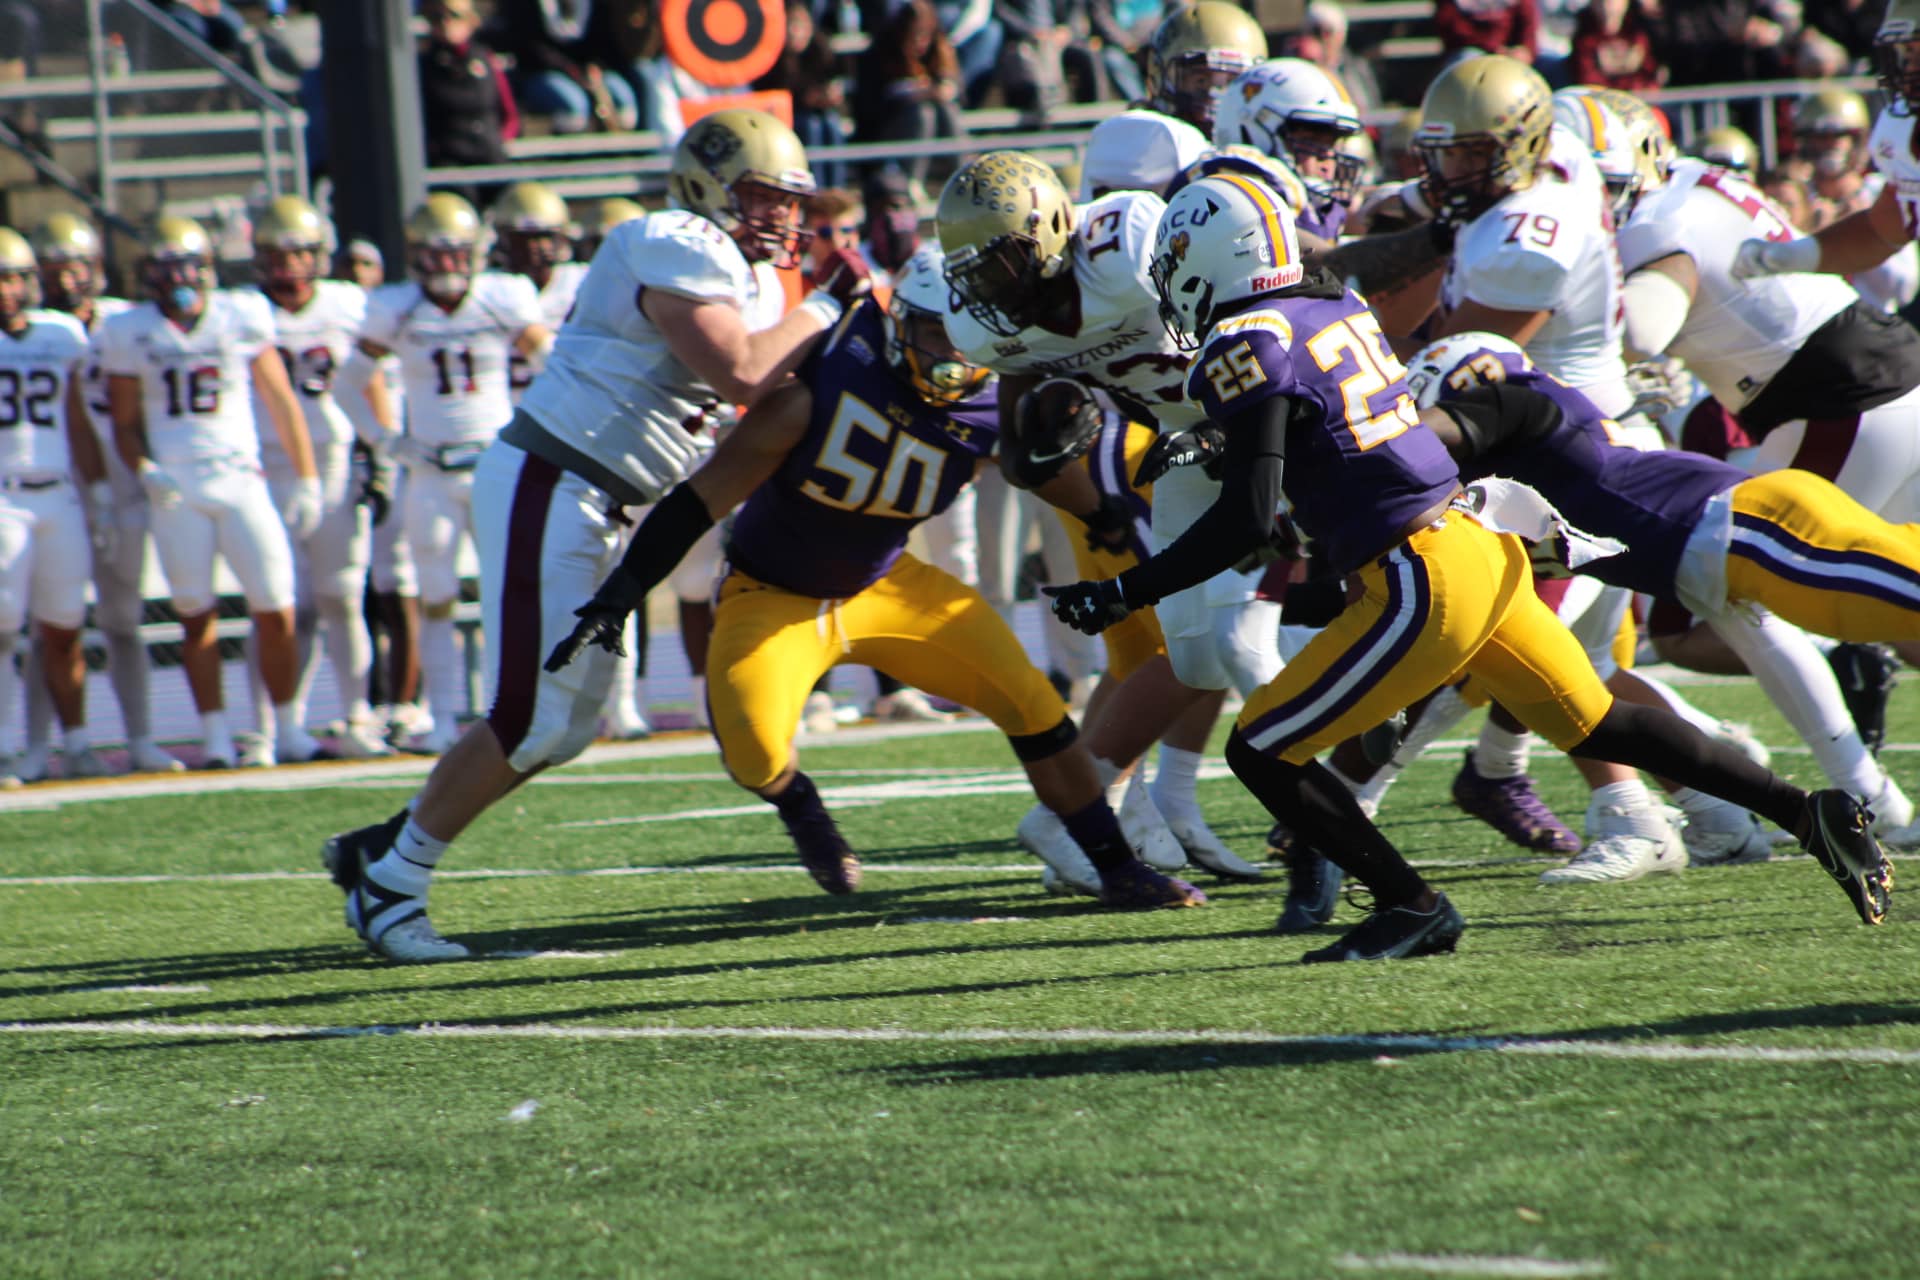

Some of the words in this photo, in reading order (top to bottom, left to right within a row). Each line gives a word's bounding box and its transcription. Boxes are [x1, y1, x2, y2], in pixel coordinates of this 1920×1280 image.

[1086, 210, 1121, 262] 13
[1503, 212, 1560, 247] 79
[1252, 266, 1301, 293] Riddell
[163, 366, 220, 418] 16
[432, 347, 477, 395] 11
[1205, 340, 1267, 402] 25
[1305, 310, 1420, 452] 25
[0, 368, 58, 428] 32
[800, 391, 949, 519] 50
